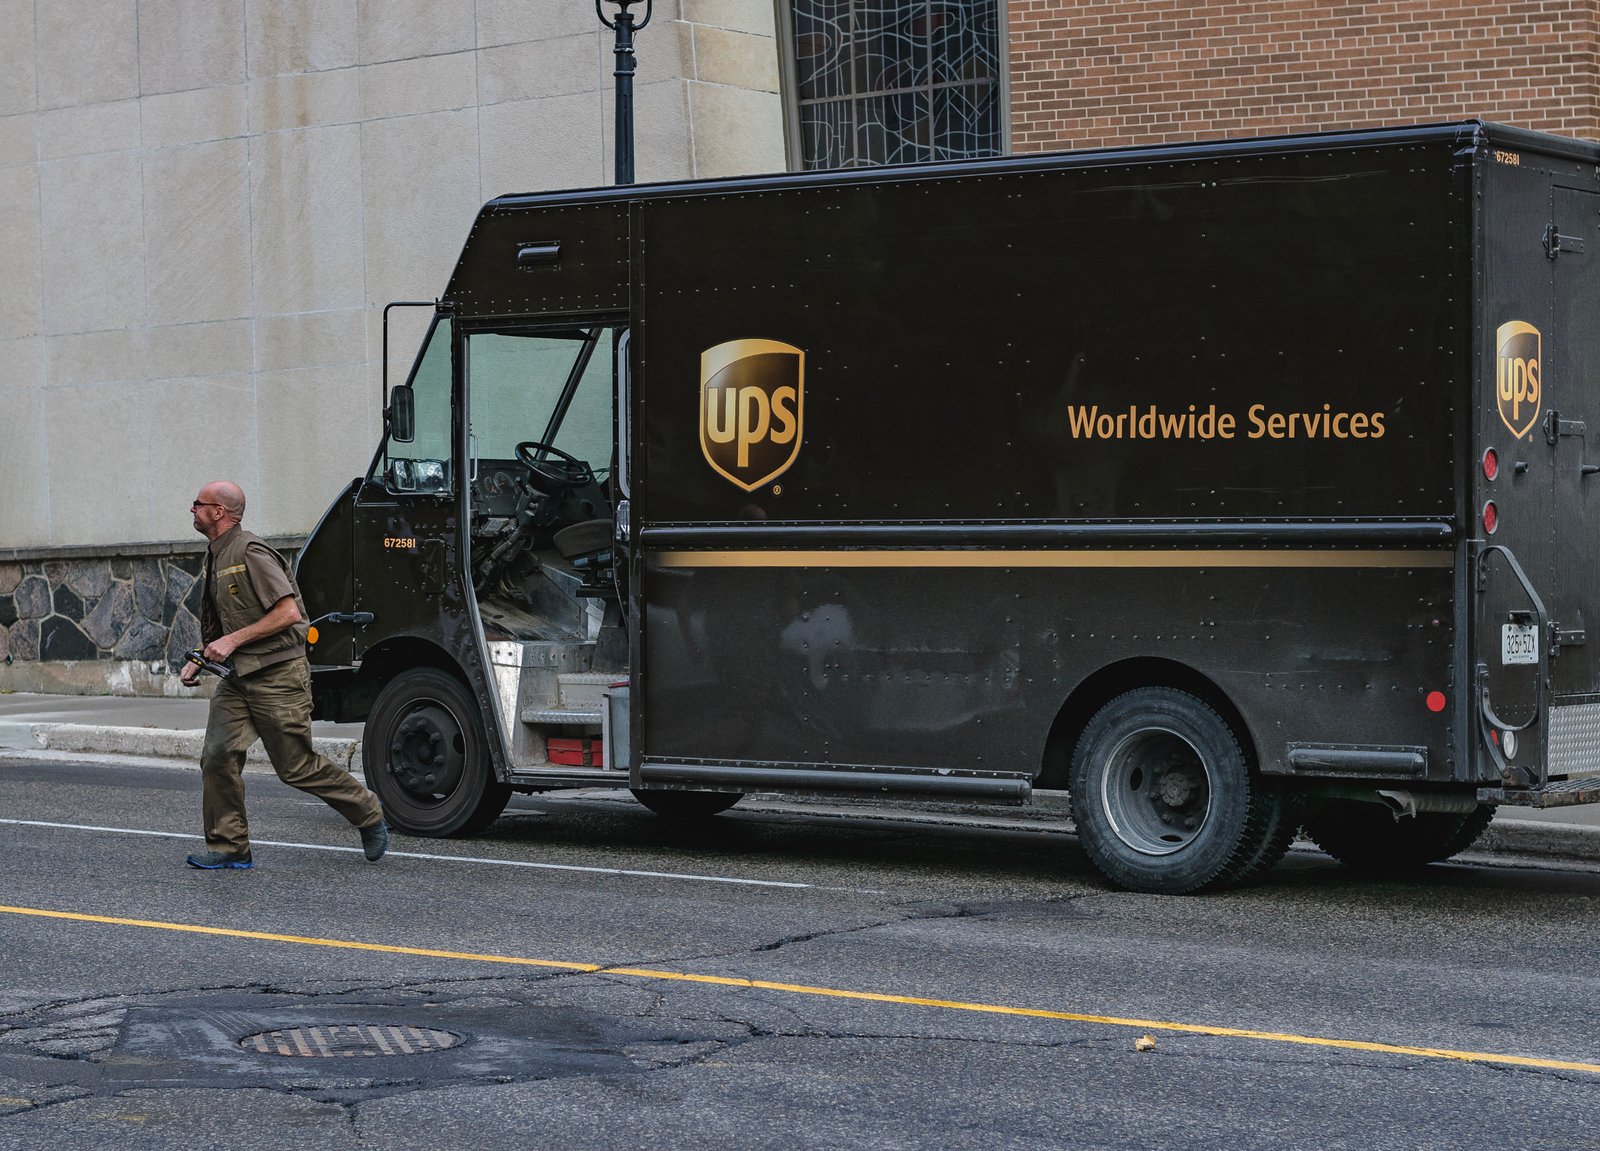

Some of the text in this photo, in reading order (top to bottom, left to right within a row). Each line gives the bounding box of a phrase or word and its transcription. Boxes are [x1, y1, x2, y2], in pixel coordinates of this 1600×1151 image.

[1496, 150, 1520, 166] 672581
[1500, 357, 1538, 420] ups
[707, 386, 797, 467] ups
[1067, 403, 1386, 439] Worldwide Services
[384, 537, 416, 548] 672581
